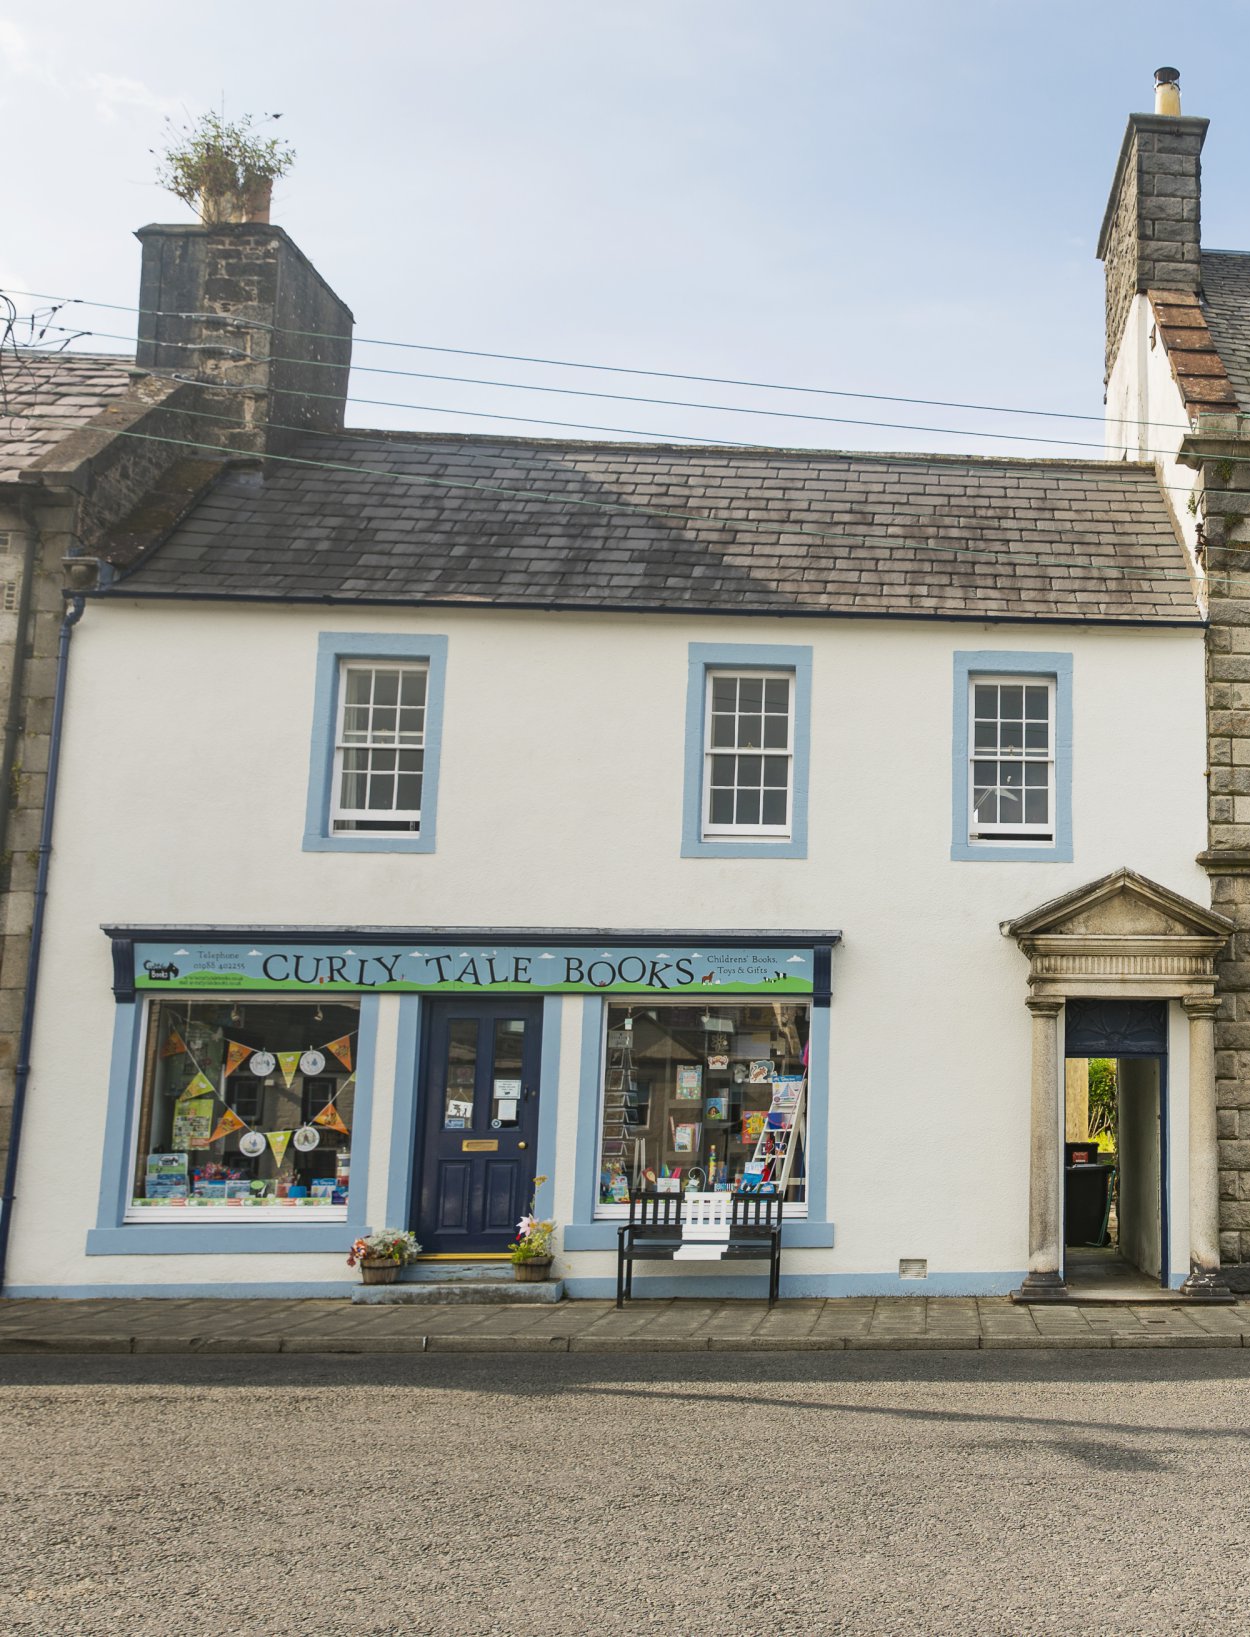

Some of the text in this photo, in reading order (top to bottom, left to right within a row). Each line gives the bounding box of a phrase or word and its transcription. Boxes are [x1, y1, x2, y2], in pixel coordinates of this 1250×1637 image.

[198, 950, 240, 961] Telephone
[193, 961, 216, 970] 01988
[262, 953, 695, 990] CURLY TALE BOOKS
[717, 966, 768, 976] Toys & Gifts
